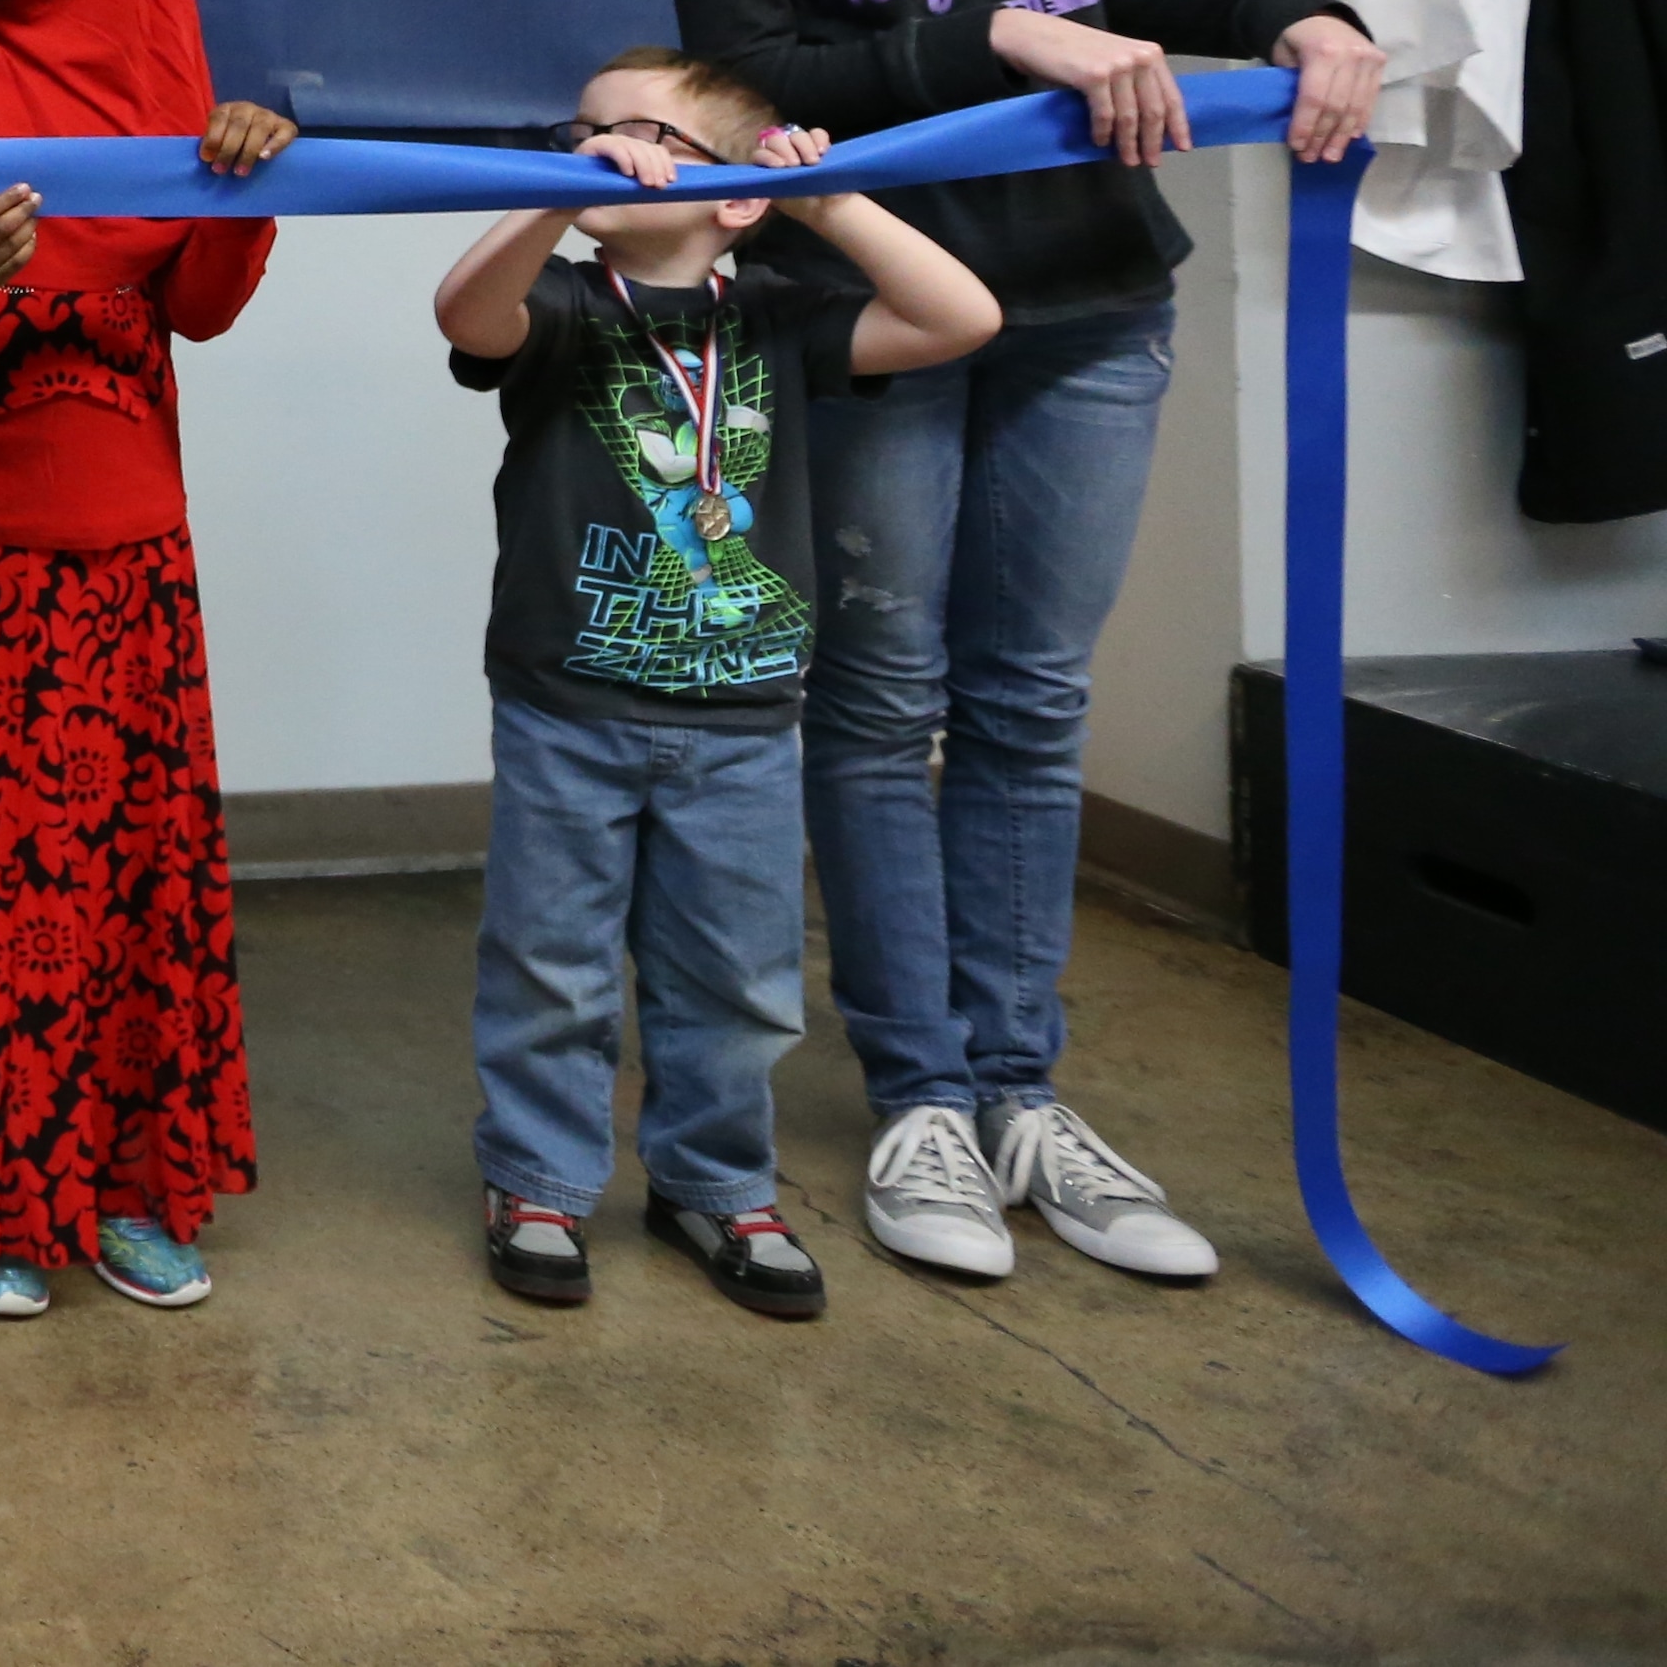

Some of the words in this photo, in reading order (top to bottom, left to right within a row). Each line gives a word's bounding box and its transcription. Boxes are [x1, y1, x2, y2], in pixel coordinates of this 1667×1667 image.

[579, 523, 658, 580] IN
[575, 575, 761, 637] THE
[563, 624, 806, 688] ZONE
